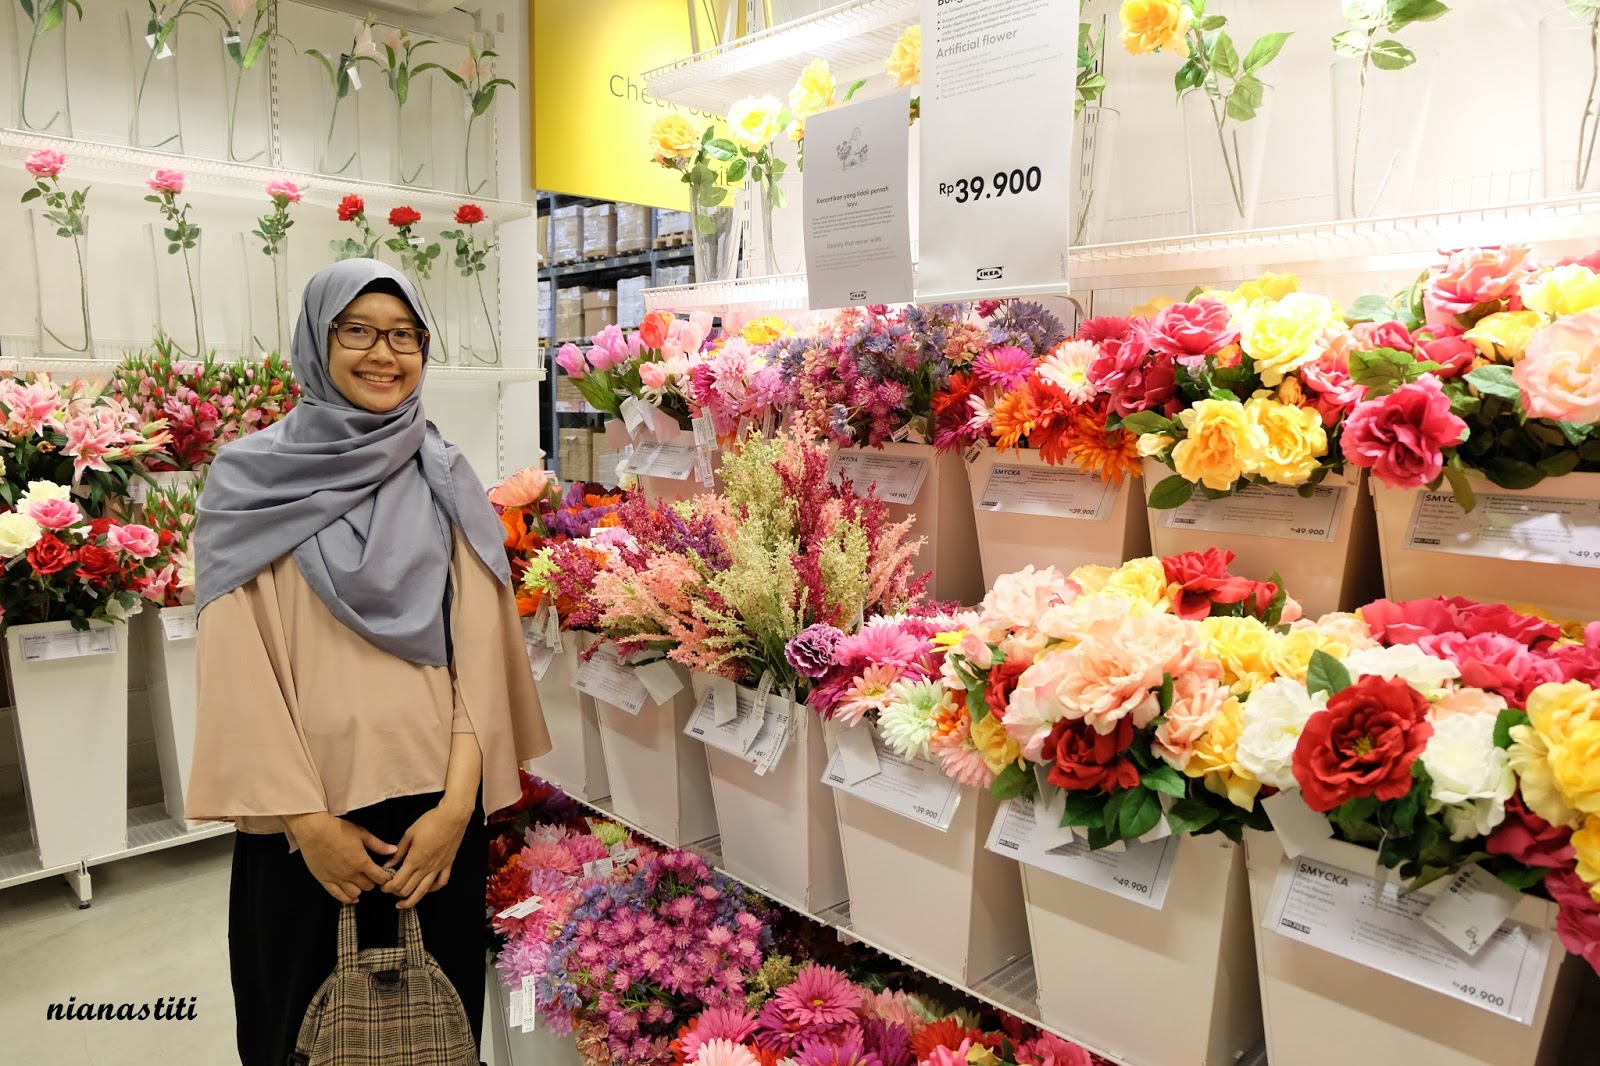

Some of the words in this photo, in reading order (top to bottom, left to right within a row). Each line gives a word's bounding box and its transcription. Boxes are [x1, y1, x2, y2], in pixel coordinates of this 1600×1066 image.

[936, 38, 980, 59] Artificial
[982, 29, 1018, 46] flower
[844, 192, 856, 200] yang
[1425, 495, 1456, 503] SMYC
[1300, 864, 1348, 887] SMYCKA
